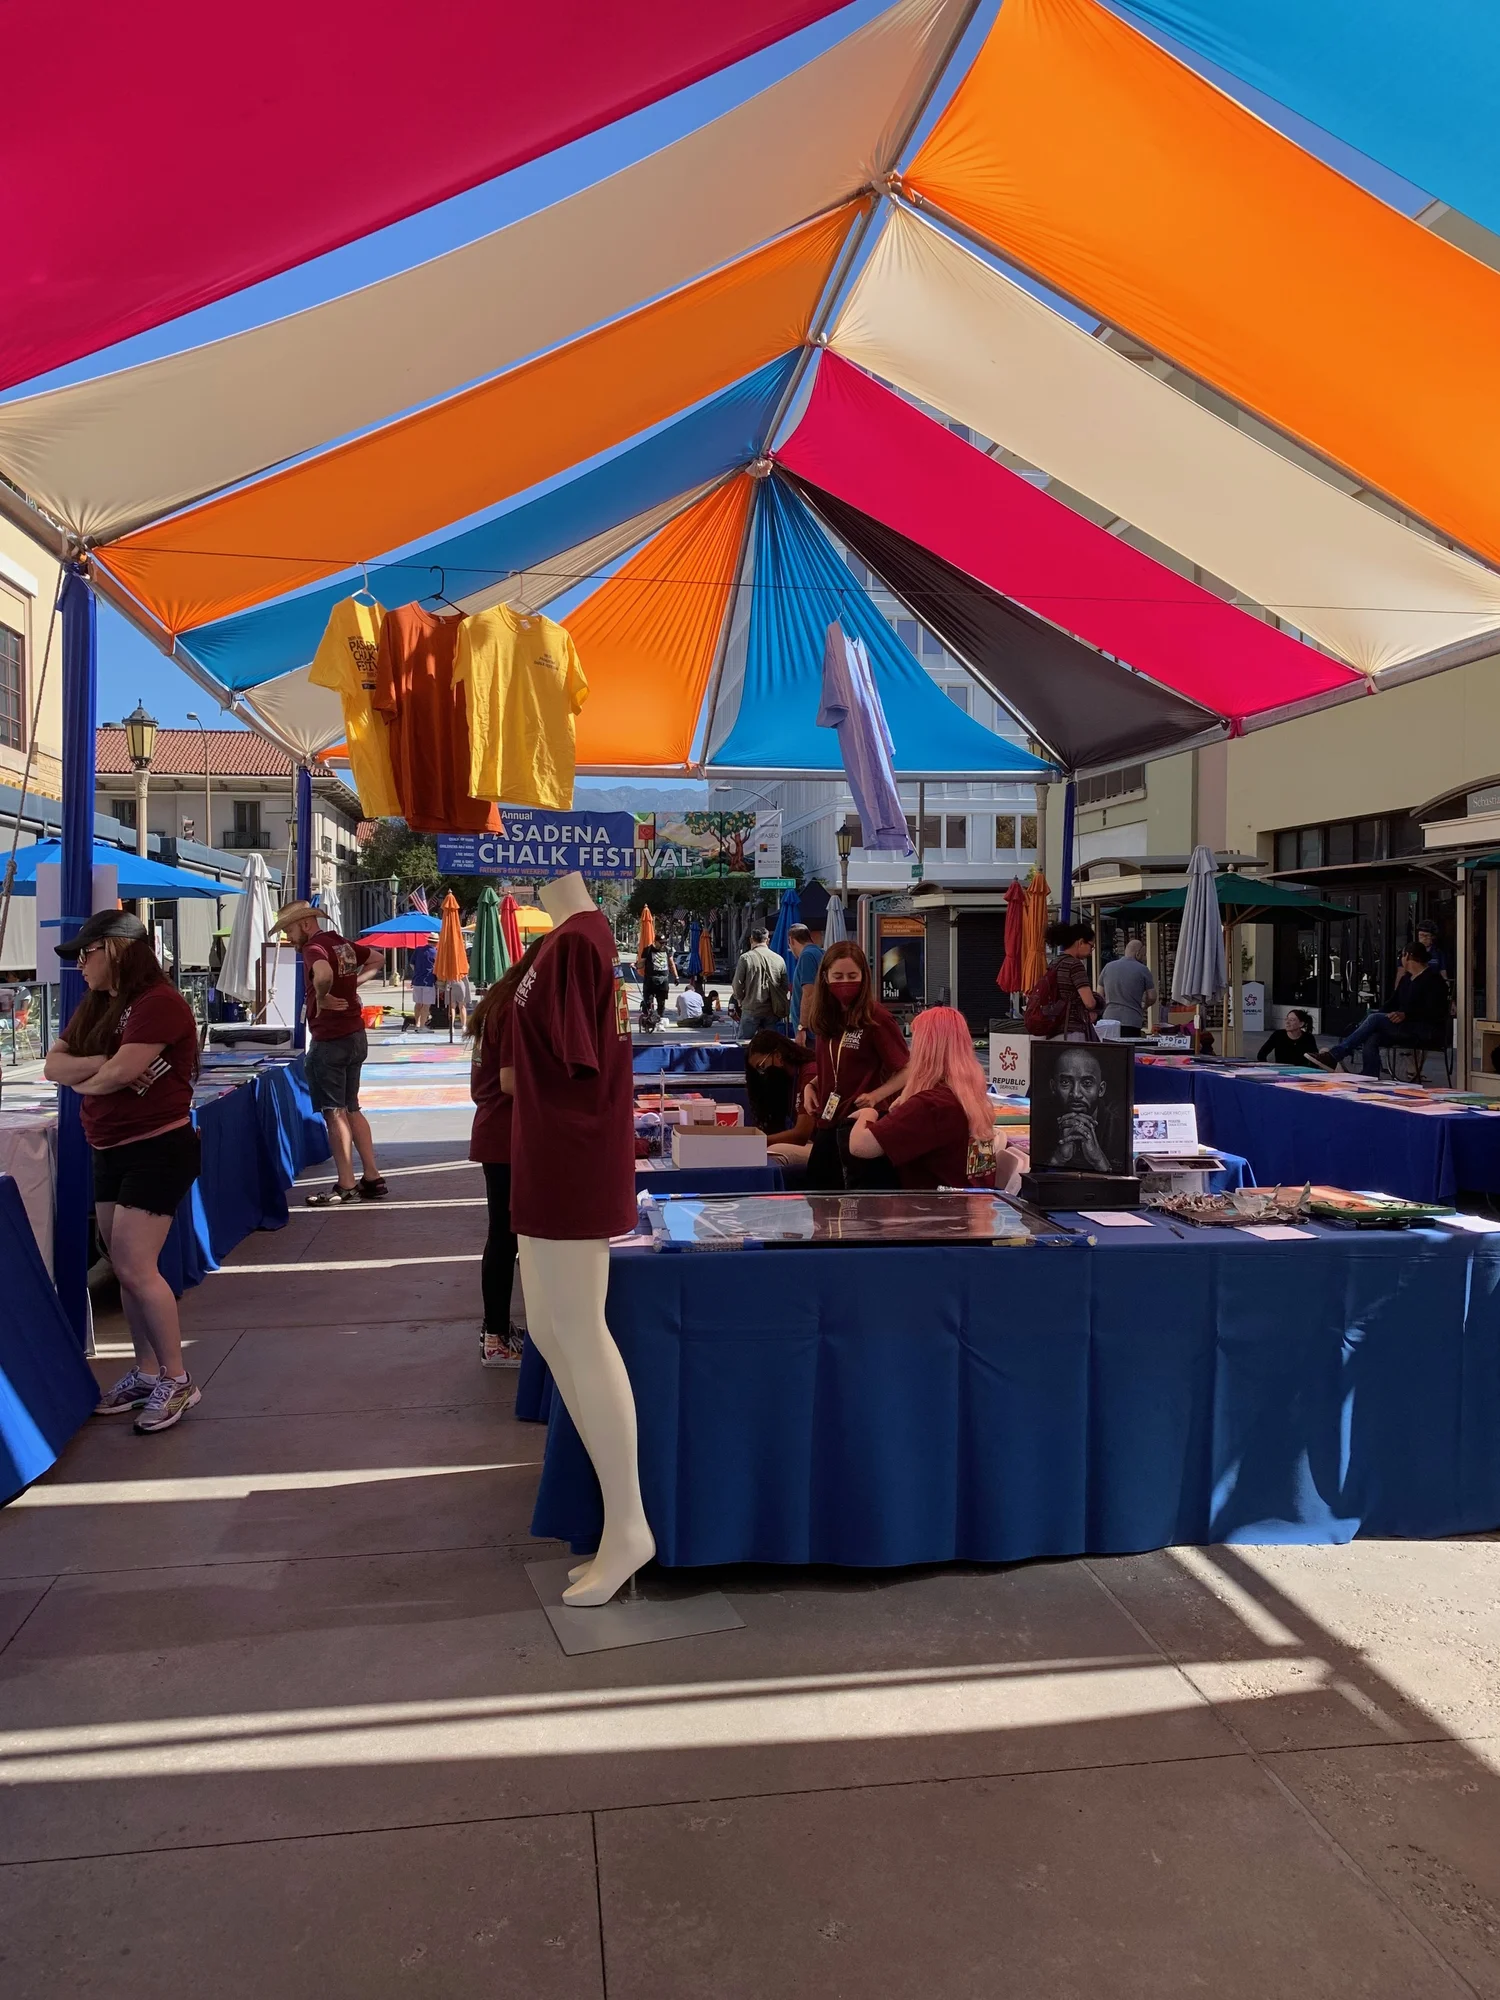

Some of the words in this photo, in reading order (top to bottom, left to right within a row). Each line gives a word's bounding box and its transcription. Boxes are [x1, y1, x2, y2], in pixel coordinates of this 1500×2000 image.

[501, 810, 533, 820] Annual
[479, 823, 611, 844] ASADENA
[478, 843, 569, 866] CHALK
[579, 847, 692, 867] FESTIVAL
[479, 867, 507, 875] FATHER'S
[521, 868, 549, 876] WEEKEND
[883, 981, 894, 989] LA
[883, 989, 899, 998] Phil
[992, 1076, 1026, 1086] REPUBLIC
